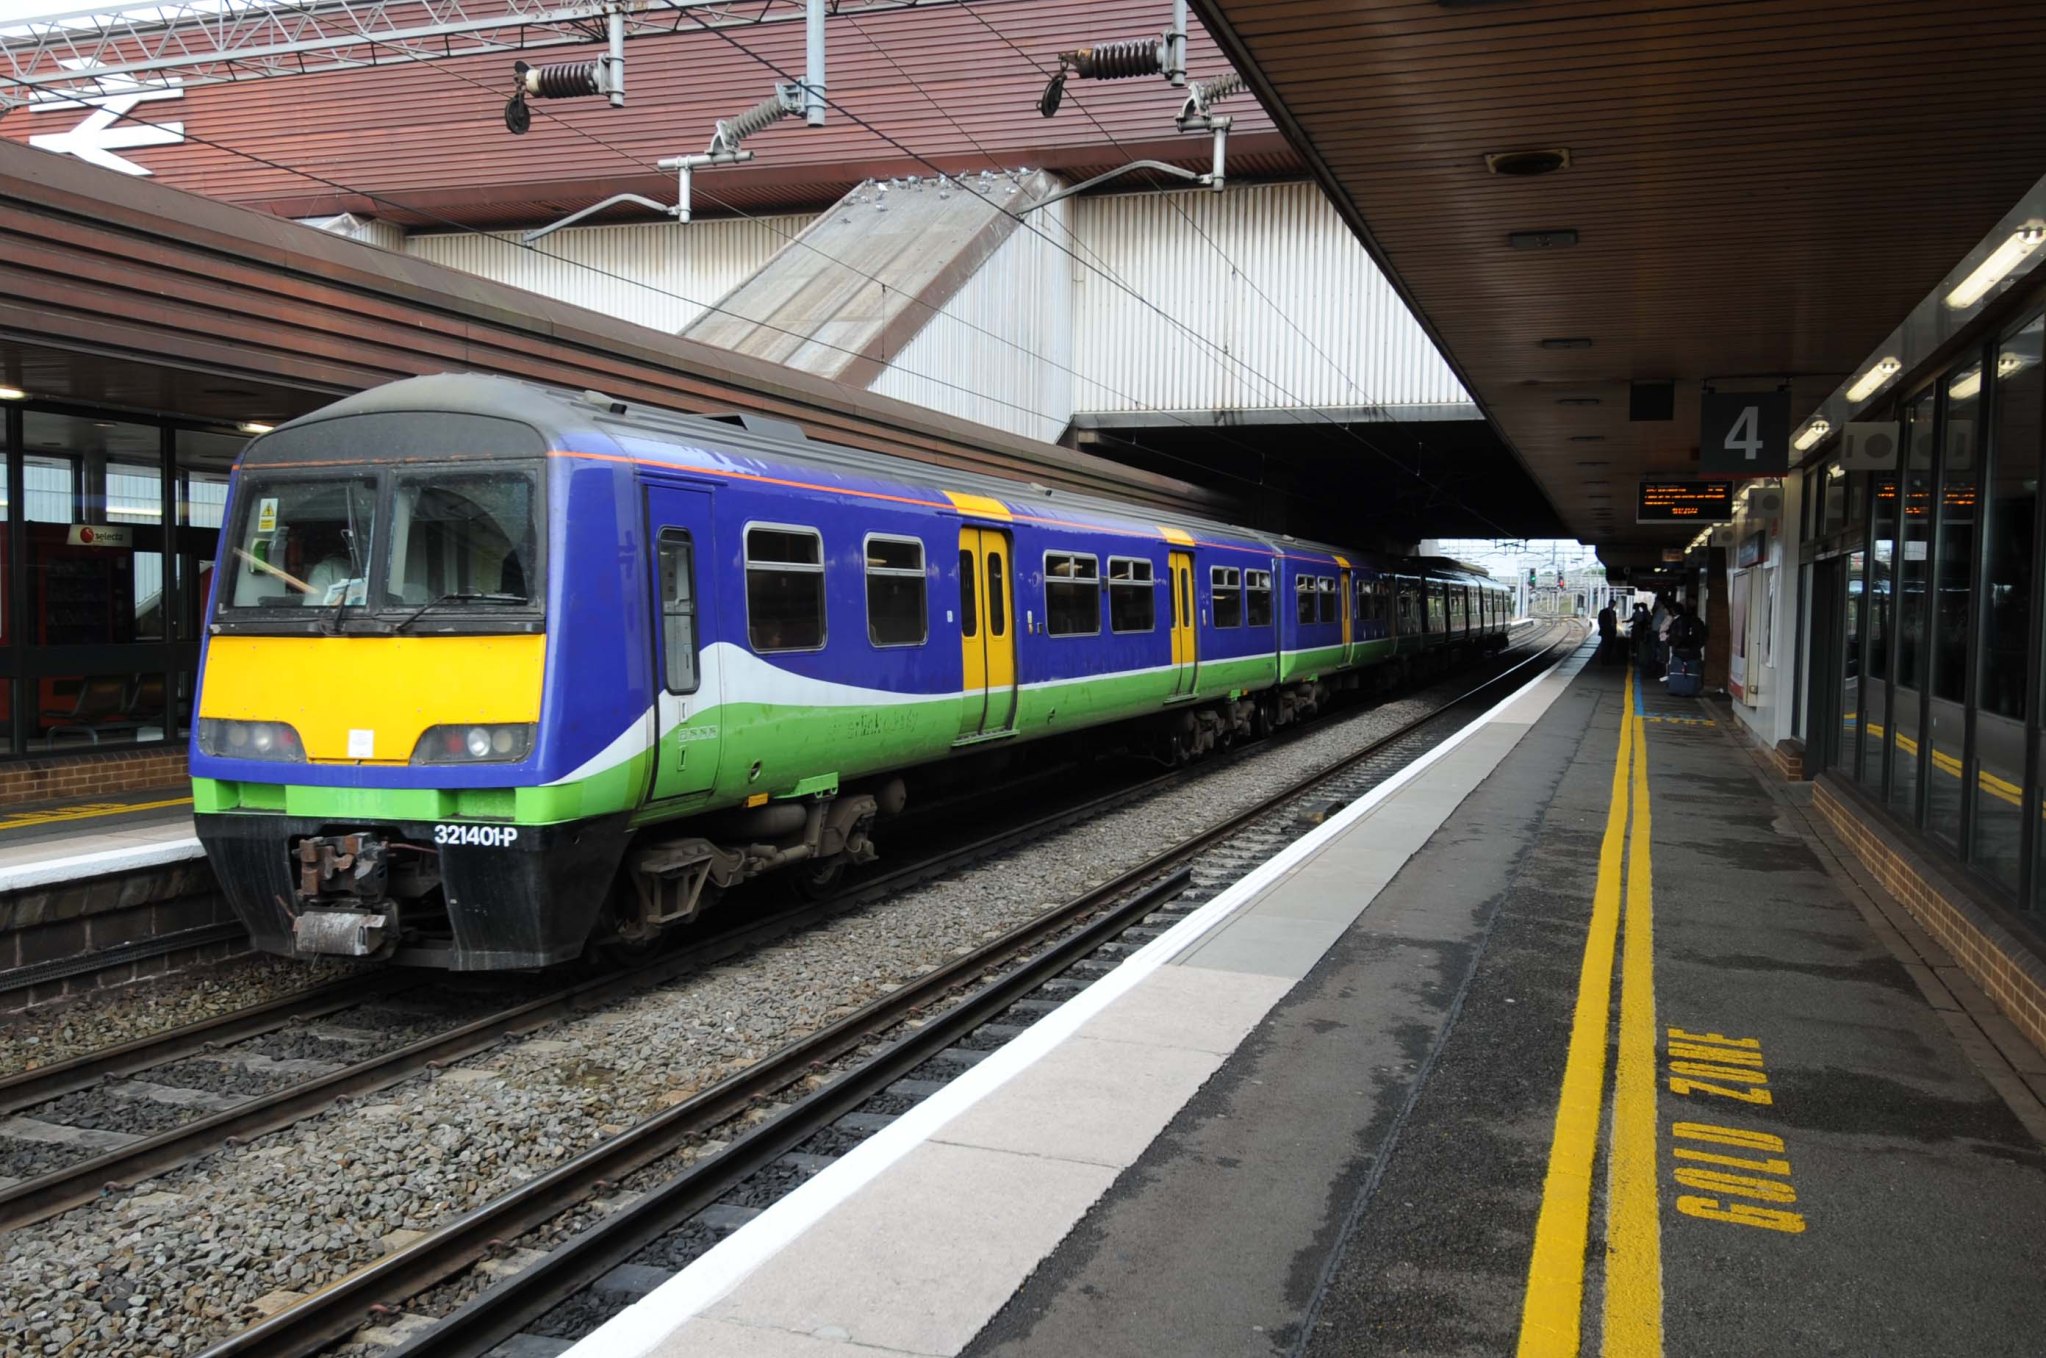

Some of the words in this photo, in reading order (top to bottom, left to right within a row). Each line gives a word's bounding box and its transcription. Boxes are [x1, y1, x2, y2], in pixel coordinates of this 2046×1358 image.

[1724, 406, 1763, 460] 4
[434, 824, 518, 847] 321401-P
[1667, 1028, 1773, 1104] ZONE
[1672, 1121, 1806, 1233] GOLD
